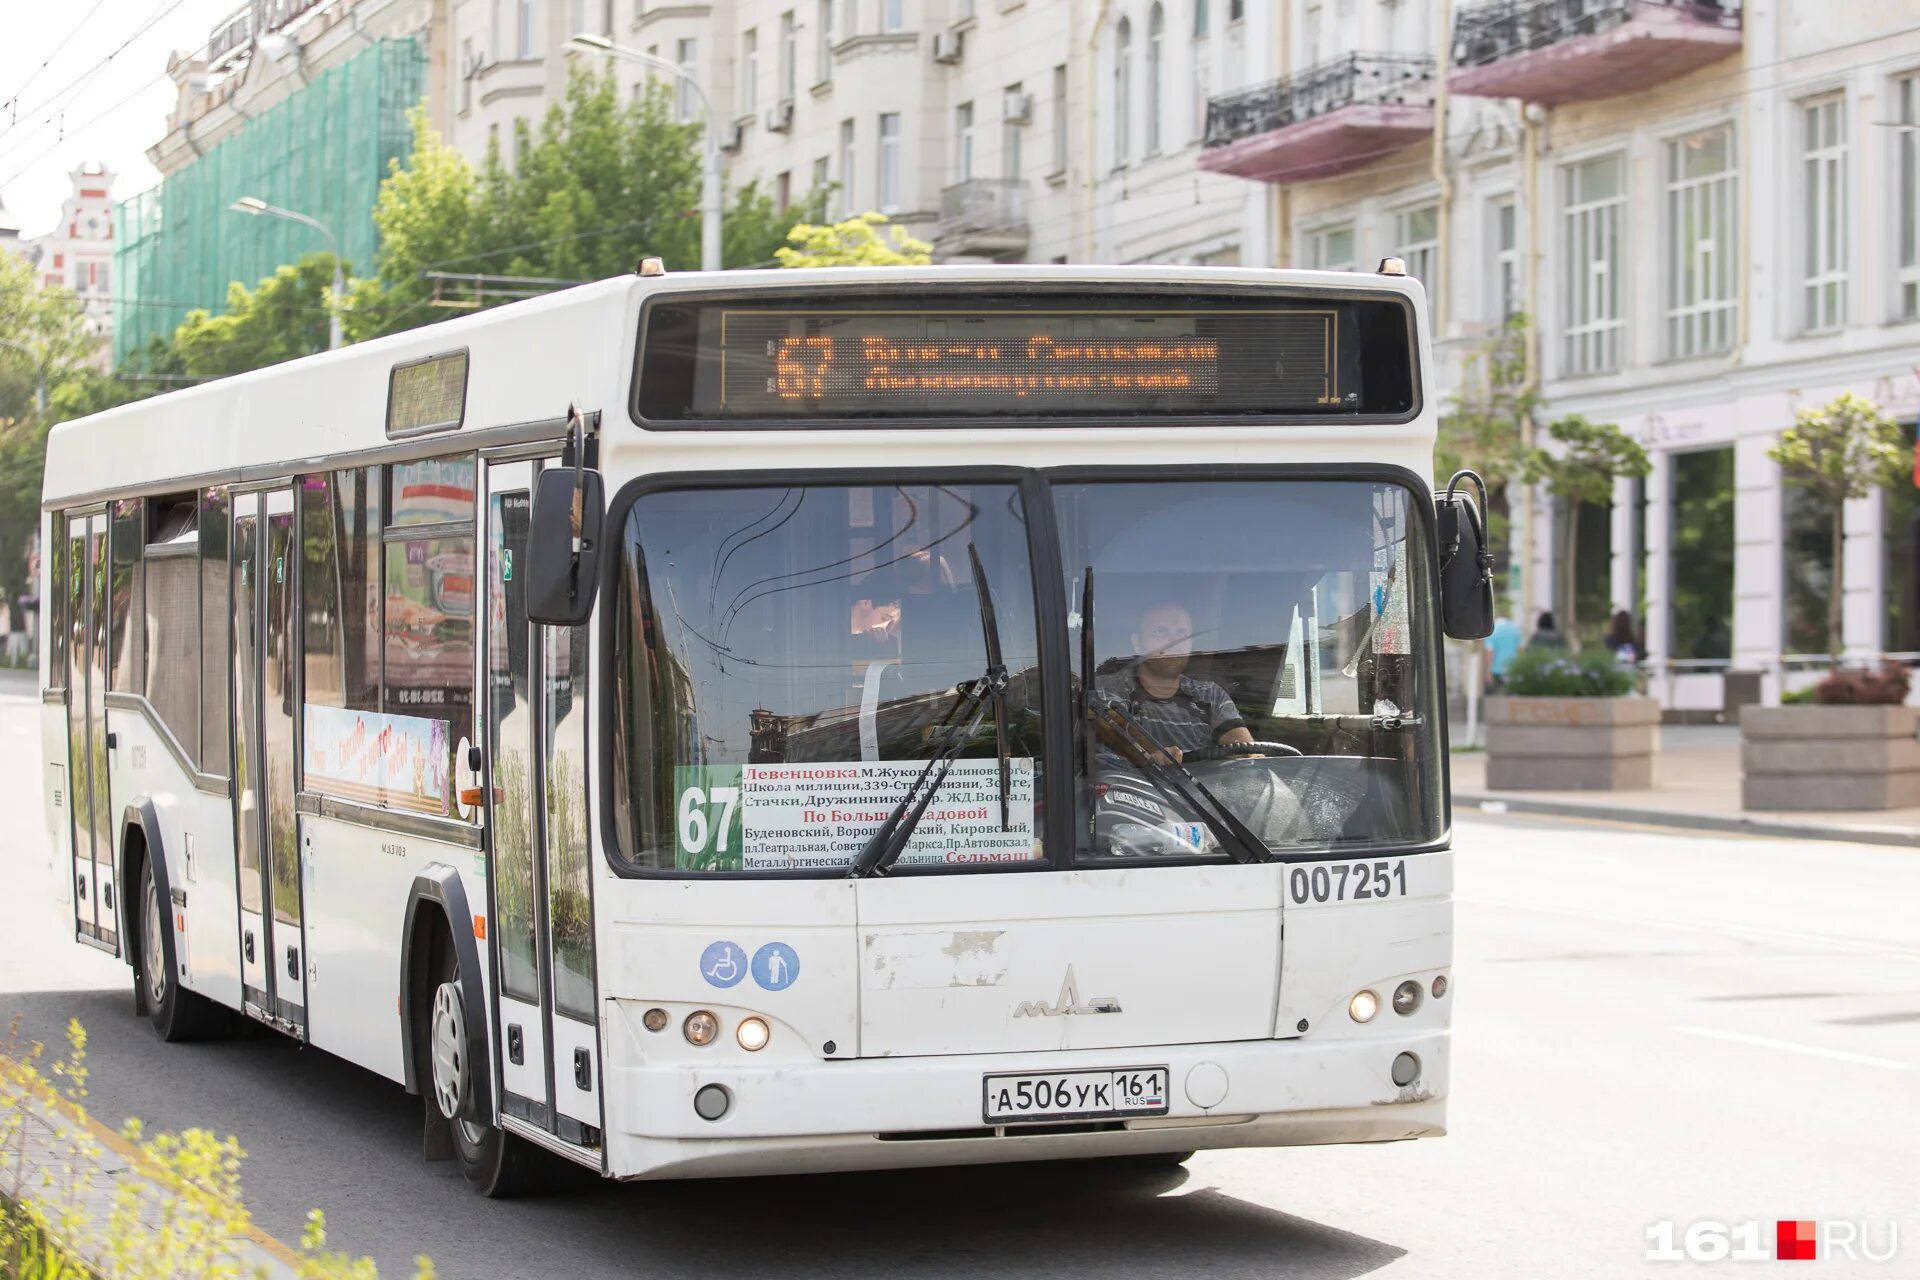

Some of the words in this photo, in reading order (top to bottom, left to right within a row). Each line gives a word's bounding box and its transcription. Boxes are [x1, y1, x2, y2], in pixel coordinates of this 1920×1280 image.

[778, 336, 832, 398] 67
[744, 783, 791, 792] Школа
[985, 777, 1031, 789] Зоге,
[678, 786, 739, 854] 67
[804, 811, 826, 823] По
[831, 808, 911, 822] Большй
[917, 806, 988, 821] адовой
[744, 827, 833, 840] Буденовский,
[946, 851, 1029, 864] Сельмаш
[1290, 860, 1407, 904] 007251
[997, 1079, 1110, 1112] А506УК
[1116, 1073, 1158, 1097] 161
[1125, 1096, 1146, 1106] RUS
